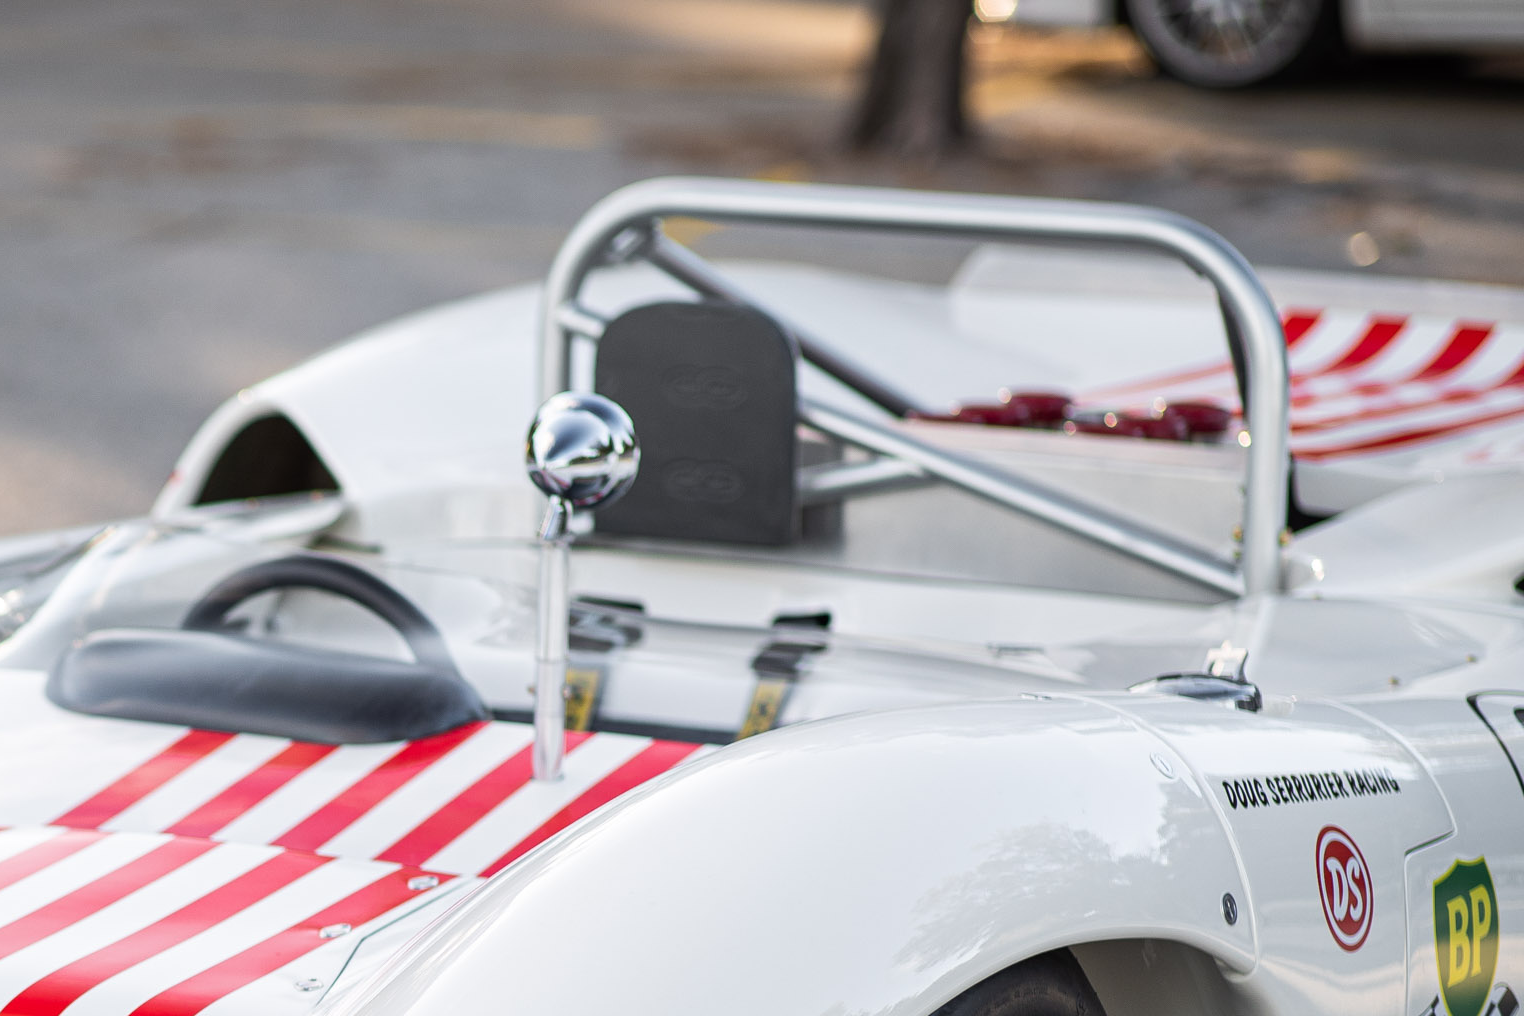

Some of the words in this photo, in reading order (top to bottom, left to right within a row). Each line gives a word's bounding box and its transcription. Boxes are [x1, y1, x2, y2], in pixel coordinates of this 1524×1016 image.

[1222, 779, 1270, 810] DOUG
[1265, 771, 1350, 806] SERRURIER
[1343, 766, 1402, 798] RACING
[1326, 855, 1363, 922] DS
[1446, 883, 1492, 989] BP
